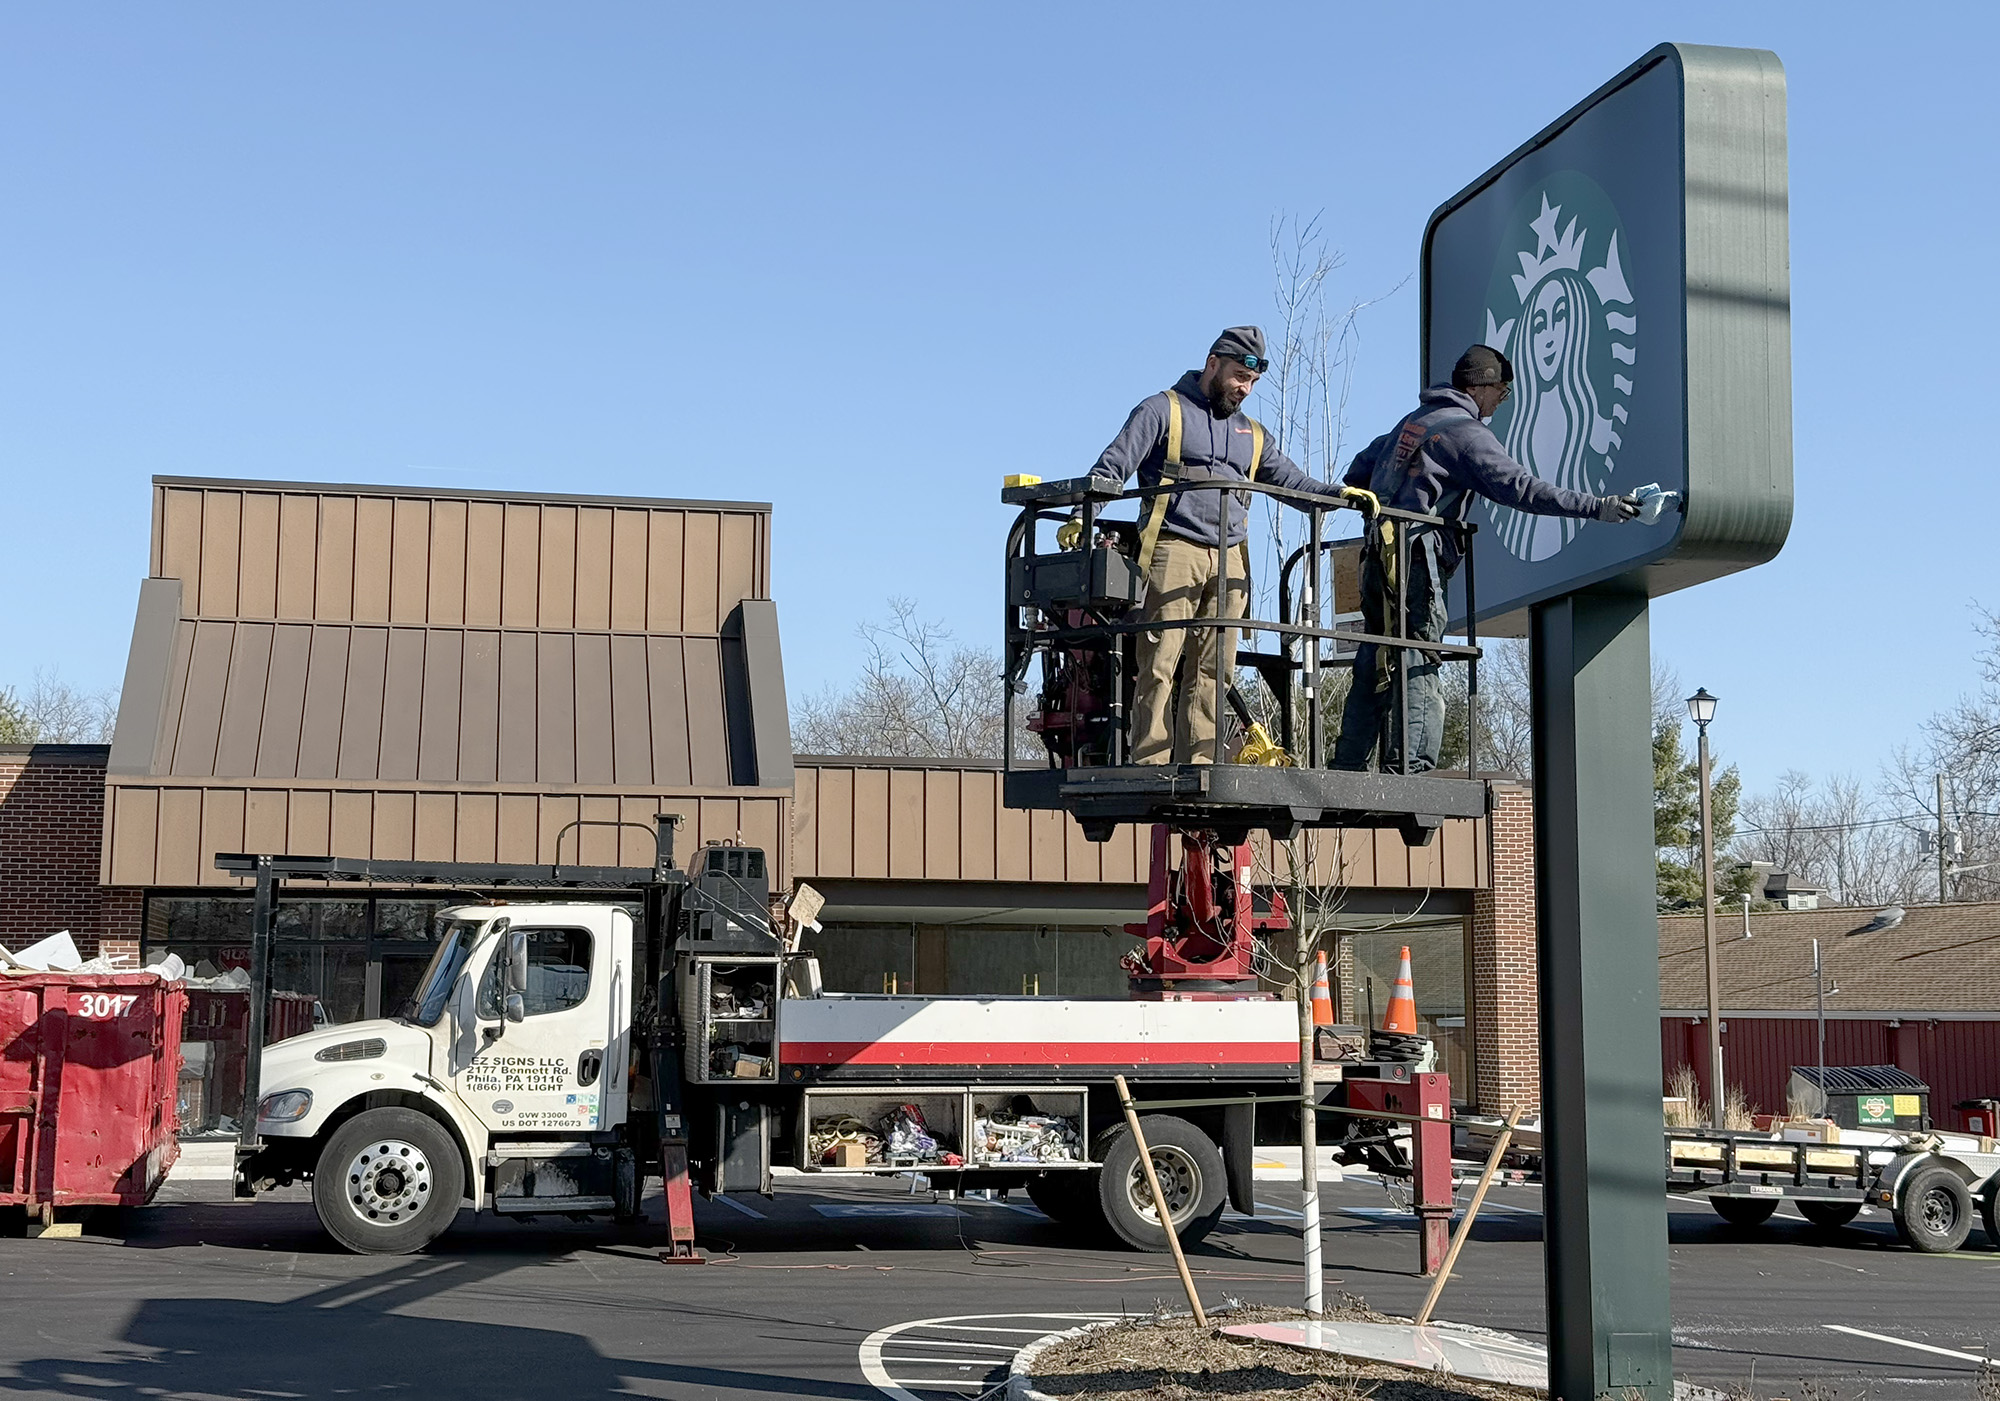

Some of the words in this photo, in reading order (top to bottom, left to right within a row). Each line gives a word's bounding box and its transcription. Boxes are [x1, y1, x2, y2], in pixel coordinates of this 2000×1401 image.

[78, 994, 139, 1018] 3017
[471, 1057, 489, 1065] EZ
[493, 1057, 535, 1066] SIGNS
[539, 1058, 565, 1066] LLC
[467, 1066, 497, 1074] 2177
[501, 1066, 549, 1074] Bennett
[553, 1067, 573, 1075] Rd.
[505, 1075, 522, 1083] PA
[526, 1075, 564, 1083] 19116
[466, 1083, 502, 1092] 1(866)
